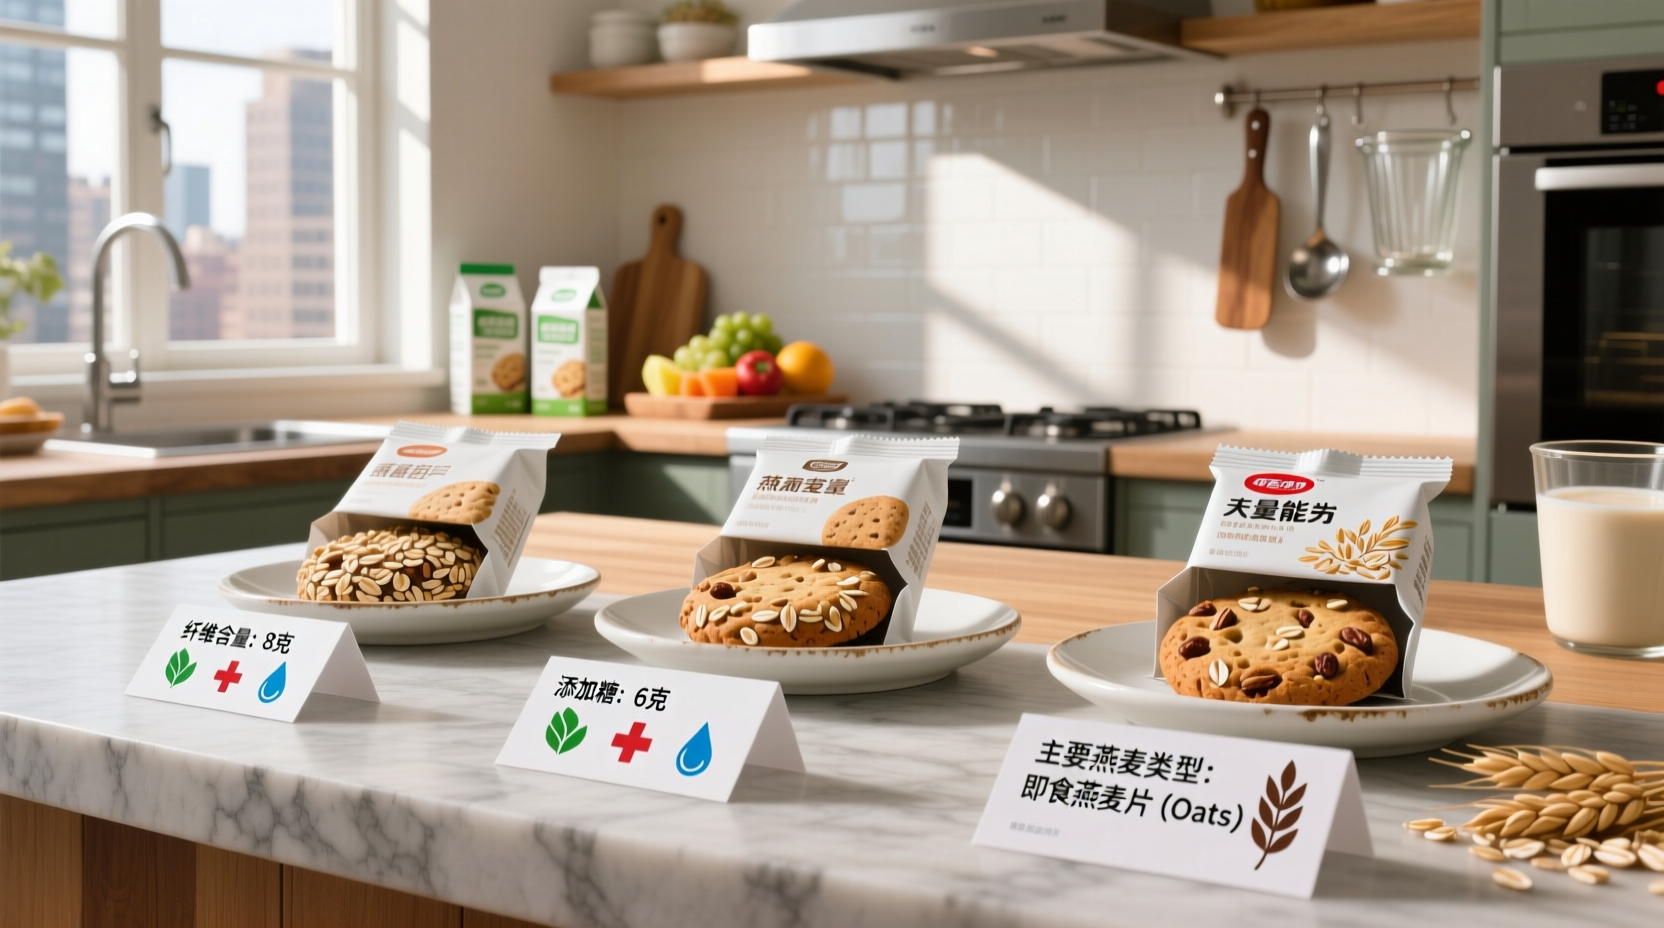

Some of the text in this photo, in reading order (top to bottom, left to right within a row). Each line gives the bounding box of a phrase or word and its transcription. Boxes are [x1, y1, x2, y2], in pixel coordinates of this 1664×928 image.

[1035, 739, 1214, 784] 主要燕麦类型：
[1021, 773, 1243, 834] 即食燕麦片 (Oats)
